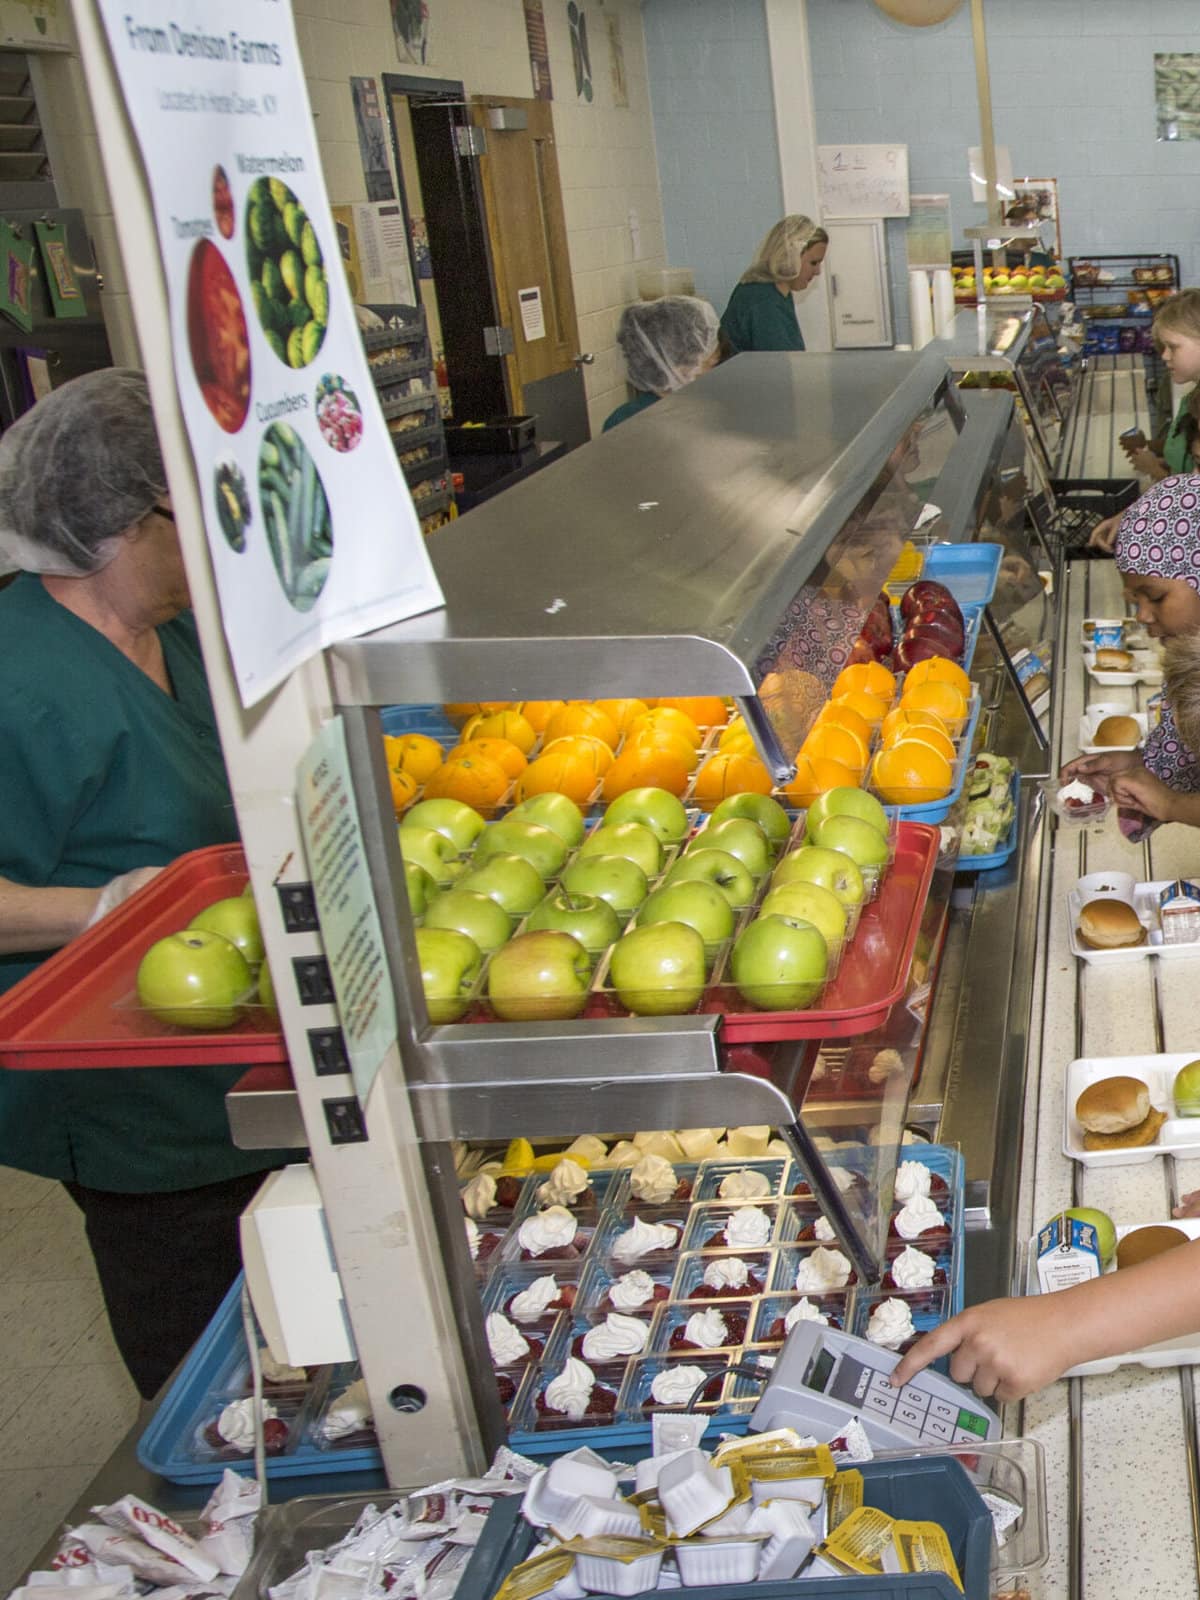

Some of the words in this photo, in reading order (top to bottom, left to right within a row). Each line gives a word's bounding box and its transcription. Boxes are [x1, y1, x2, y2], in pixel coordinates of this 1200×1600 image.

[124, 15, 172, 54] From
[170, 22, 229, 61] Denison
[229, 31, 282, 66] Farms
[234, 152, 304, 173] Watermelon
[256, 392, 309, 422] Cucumbers
[873, 1397, 887, 1407] 8
[908, 1392, 923, 1403] 6
[902, 1410, 917, 1421] 5
[937, 1406, 951, 1416] 3
[932, 1423, 947, 1434] 2
